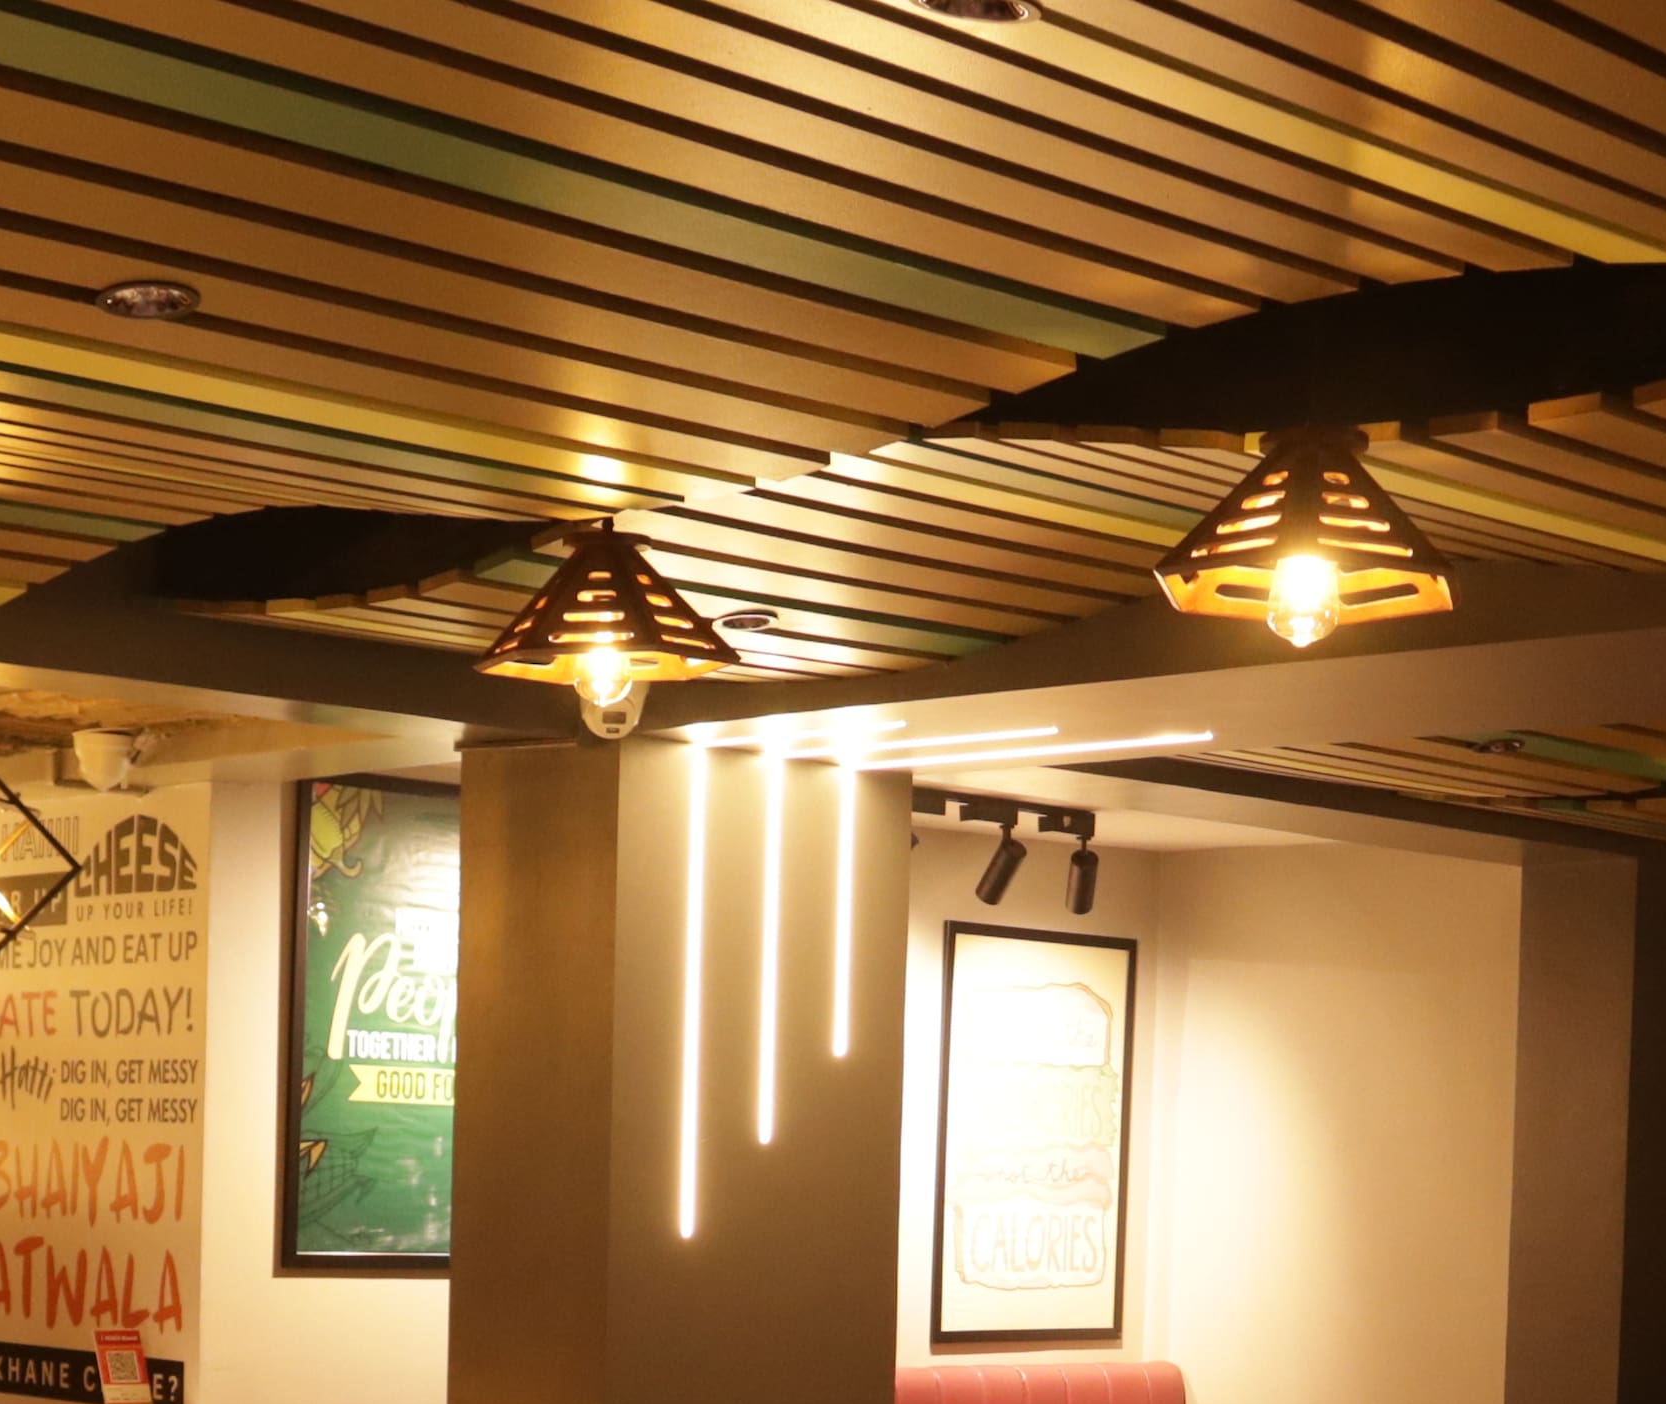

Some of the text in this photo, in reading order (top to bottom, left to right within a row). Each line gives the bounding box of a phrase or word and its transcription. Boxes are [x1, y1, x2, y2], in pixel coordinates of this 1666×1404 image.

[73, 813, 199, 898] CHEESE
[76, 897, 193, 922] UP YOUR LIFE!
[32, 936, 66, 967] JOY
[71, 935, 116, 966] AND
[122, 932, 161, 964] EAT
[168, 930, 199, 962] UP
[69, 986, 194, 1039] TODAY!
[346, 1028, 437, 1062] TOGETHER
[60, 1058, 199, 1086] DIG IN, GET MESSY
[376, 1070, 426, 1100] GOOD
[59, 1097, 199, 1125] DIG IN, GET MESSY
[970, 1213, 1098, 1273] CALORIES
[84, 1366, 179, 1401] CE?
